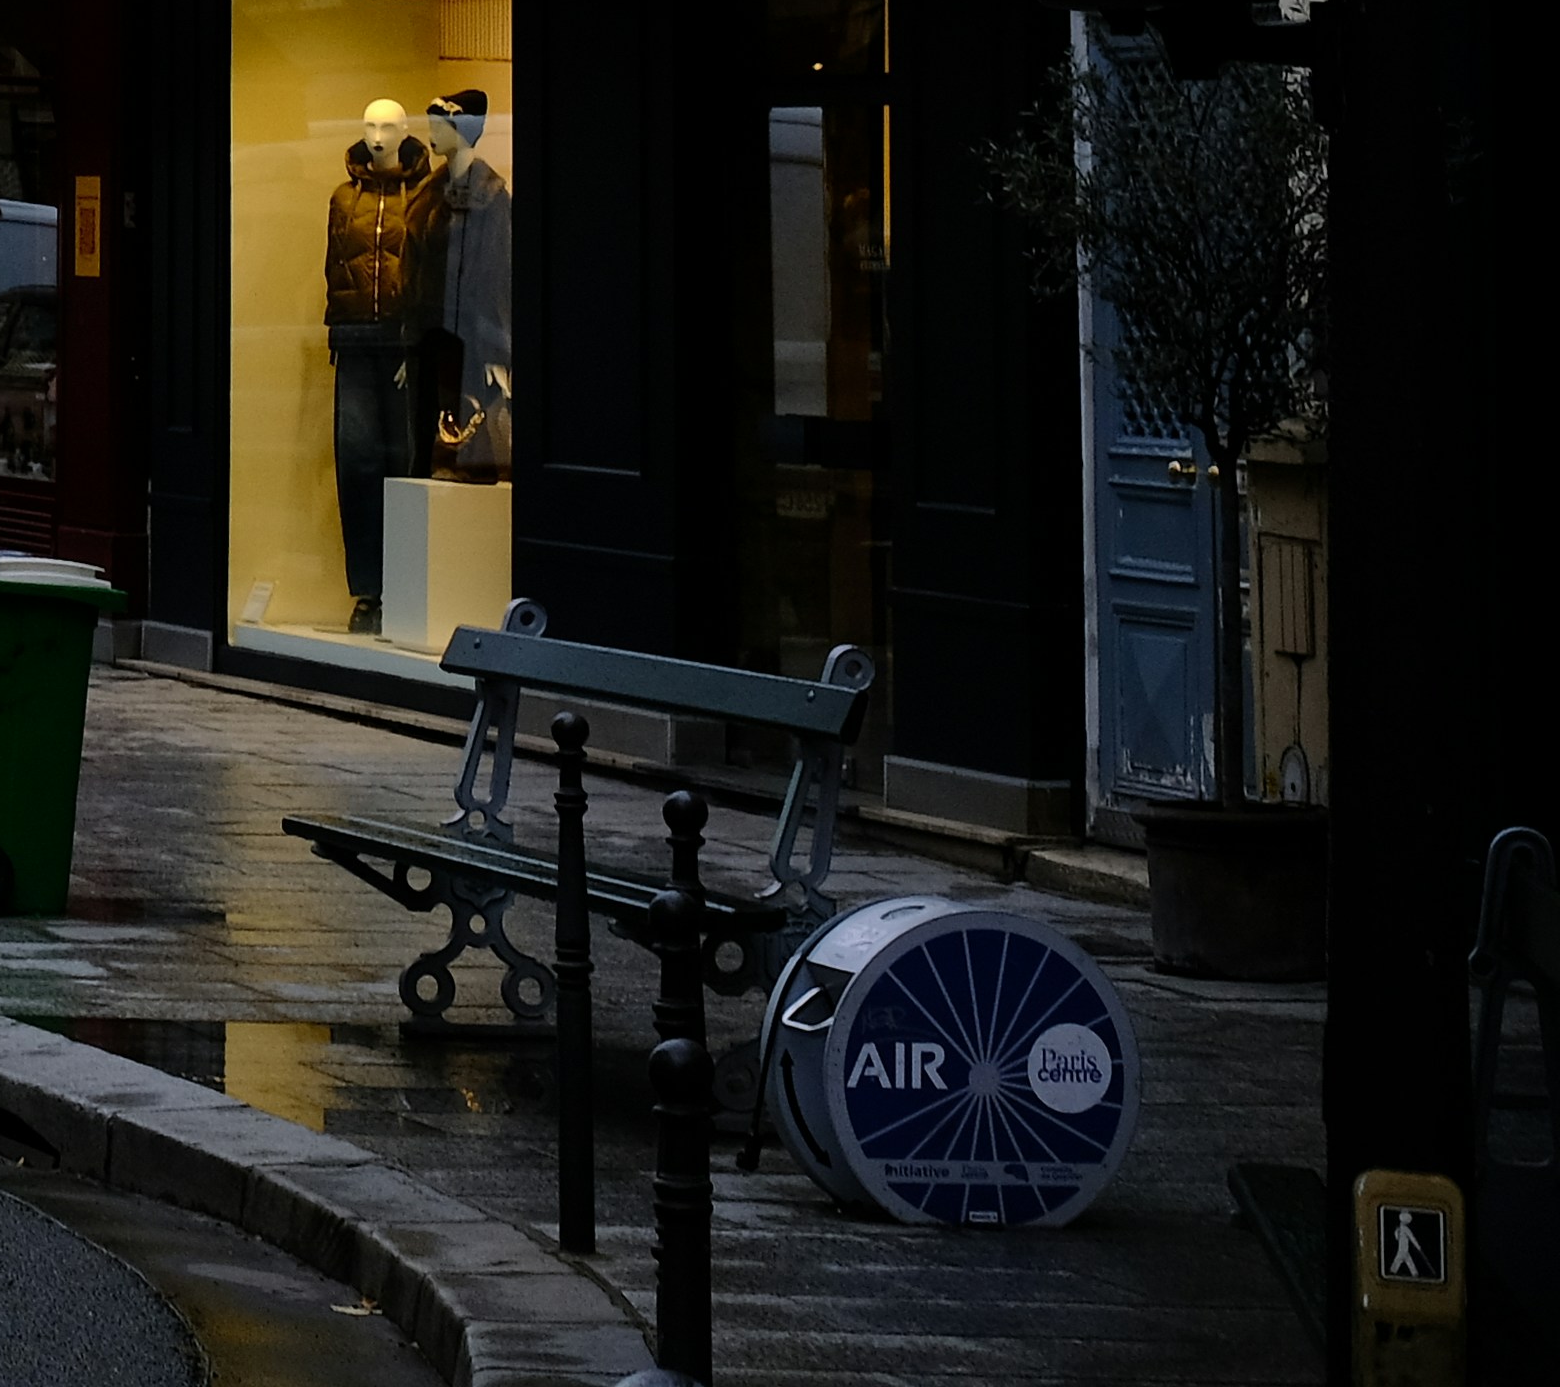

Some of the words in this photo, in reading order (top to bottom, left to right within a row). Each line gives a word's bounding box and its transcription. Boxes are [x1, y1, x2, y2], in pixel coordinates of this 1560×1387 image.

[846, 1041, 949, 1091] AIR
[1040, 1047, 1098, 1072] Paris
[1037, 1068, 1103, 1084] centre
[884, 1163, 950, 1178] Initiative
